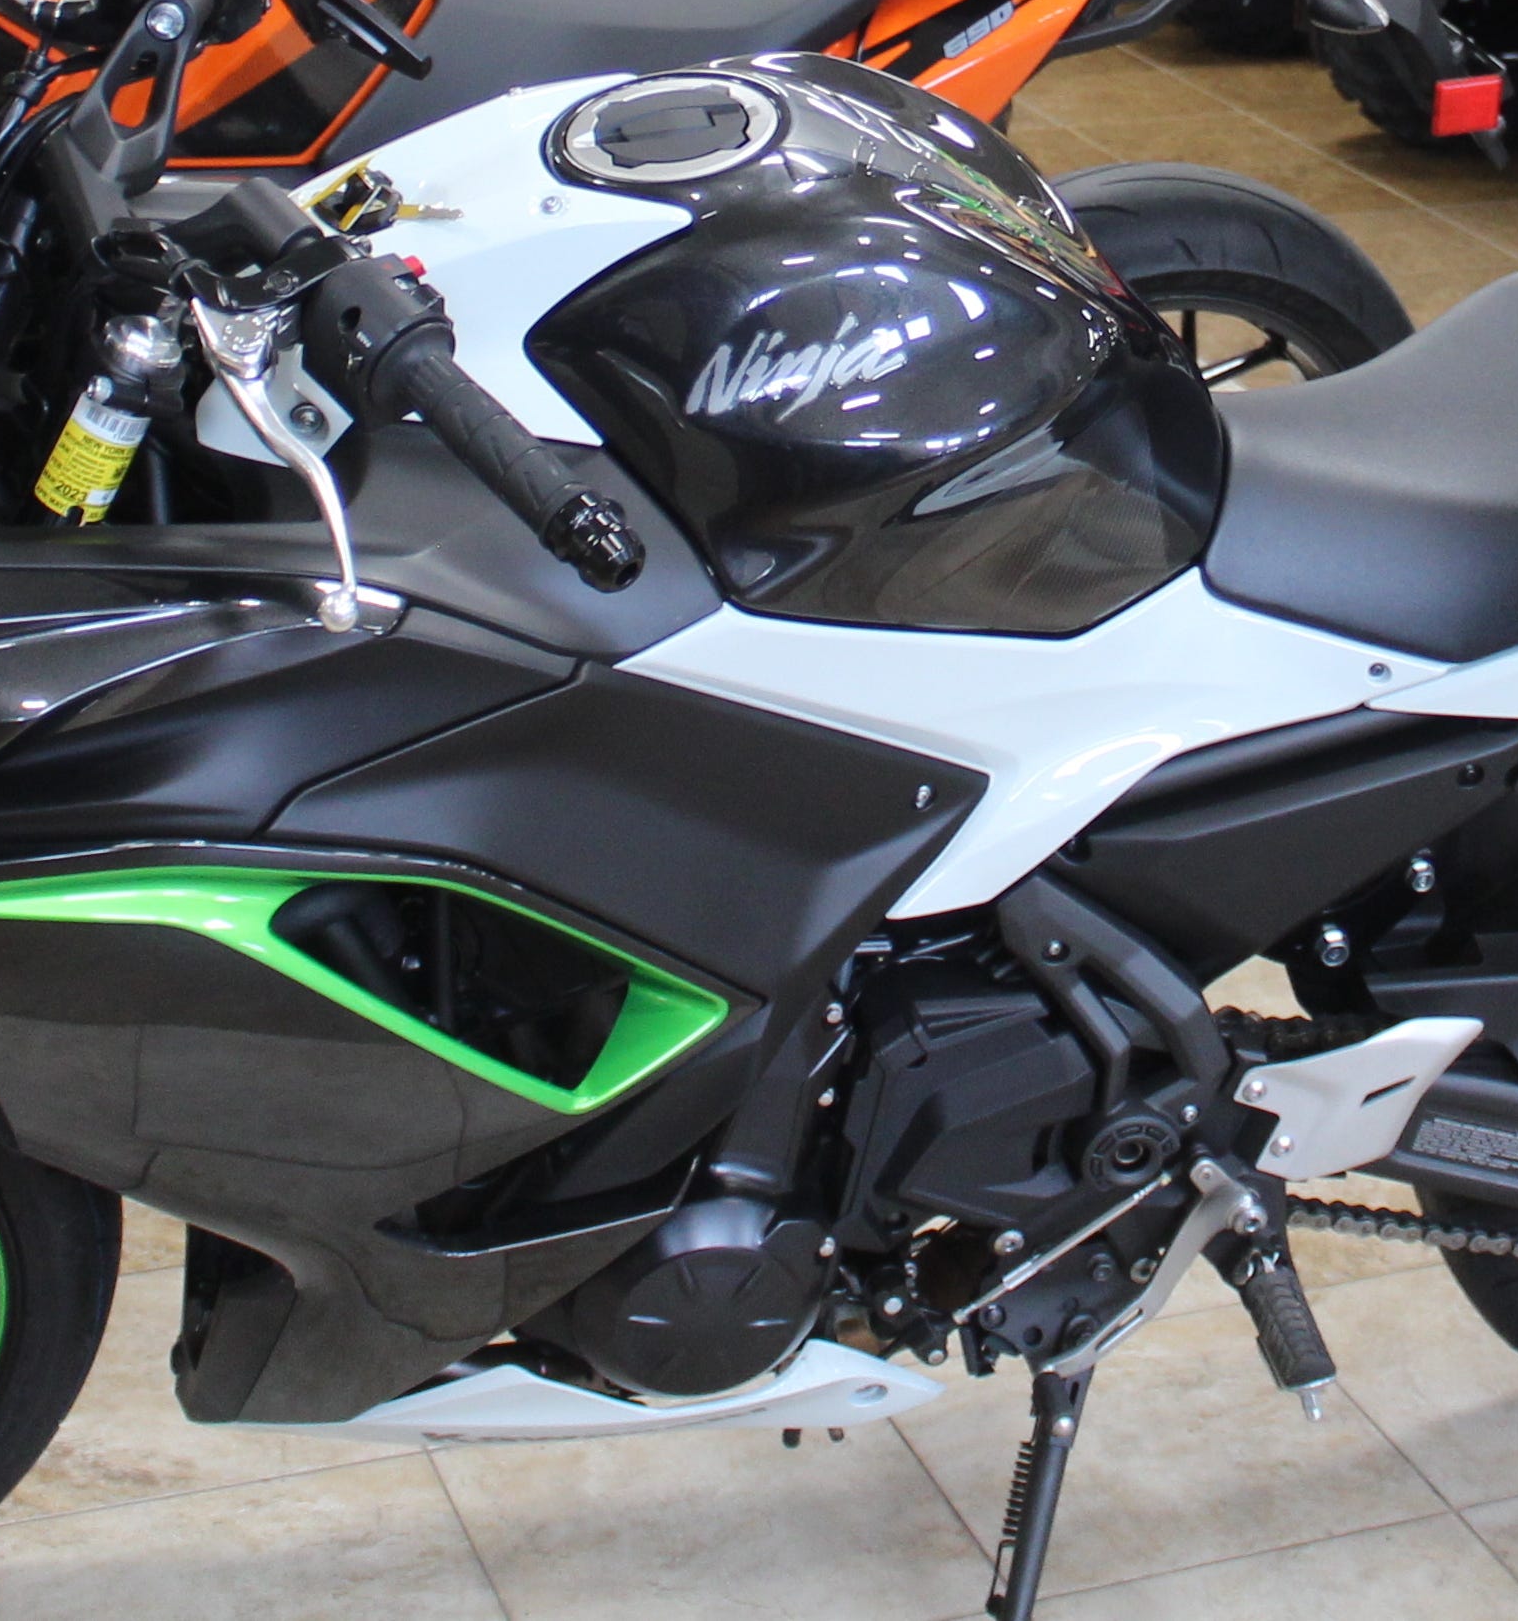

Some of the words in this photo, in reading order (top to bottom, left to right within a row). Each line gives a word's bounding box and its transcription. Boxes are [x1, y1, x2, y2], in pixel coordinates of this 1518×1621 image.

[685, 311, 907, 425] Ninja
[82, 435, 104, 452] NEW
[104, 444, 127, 455] YORK
[55, 480, 88, 503] 2023
